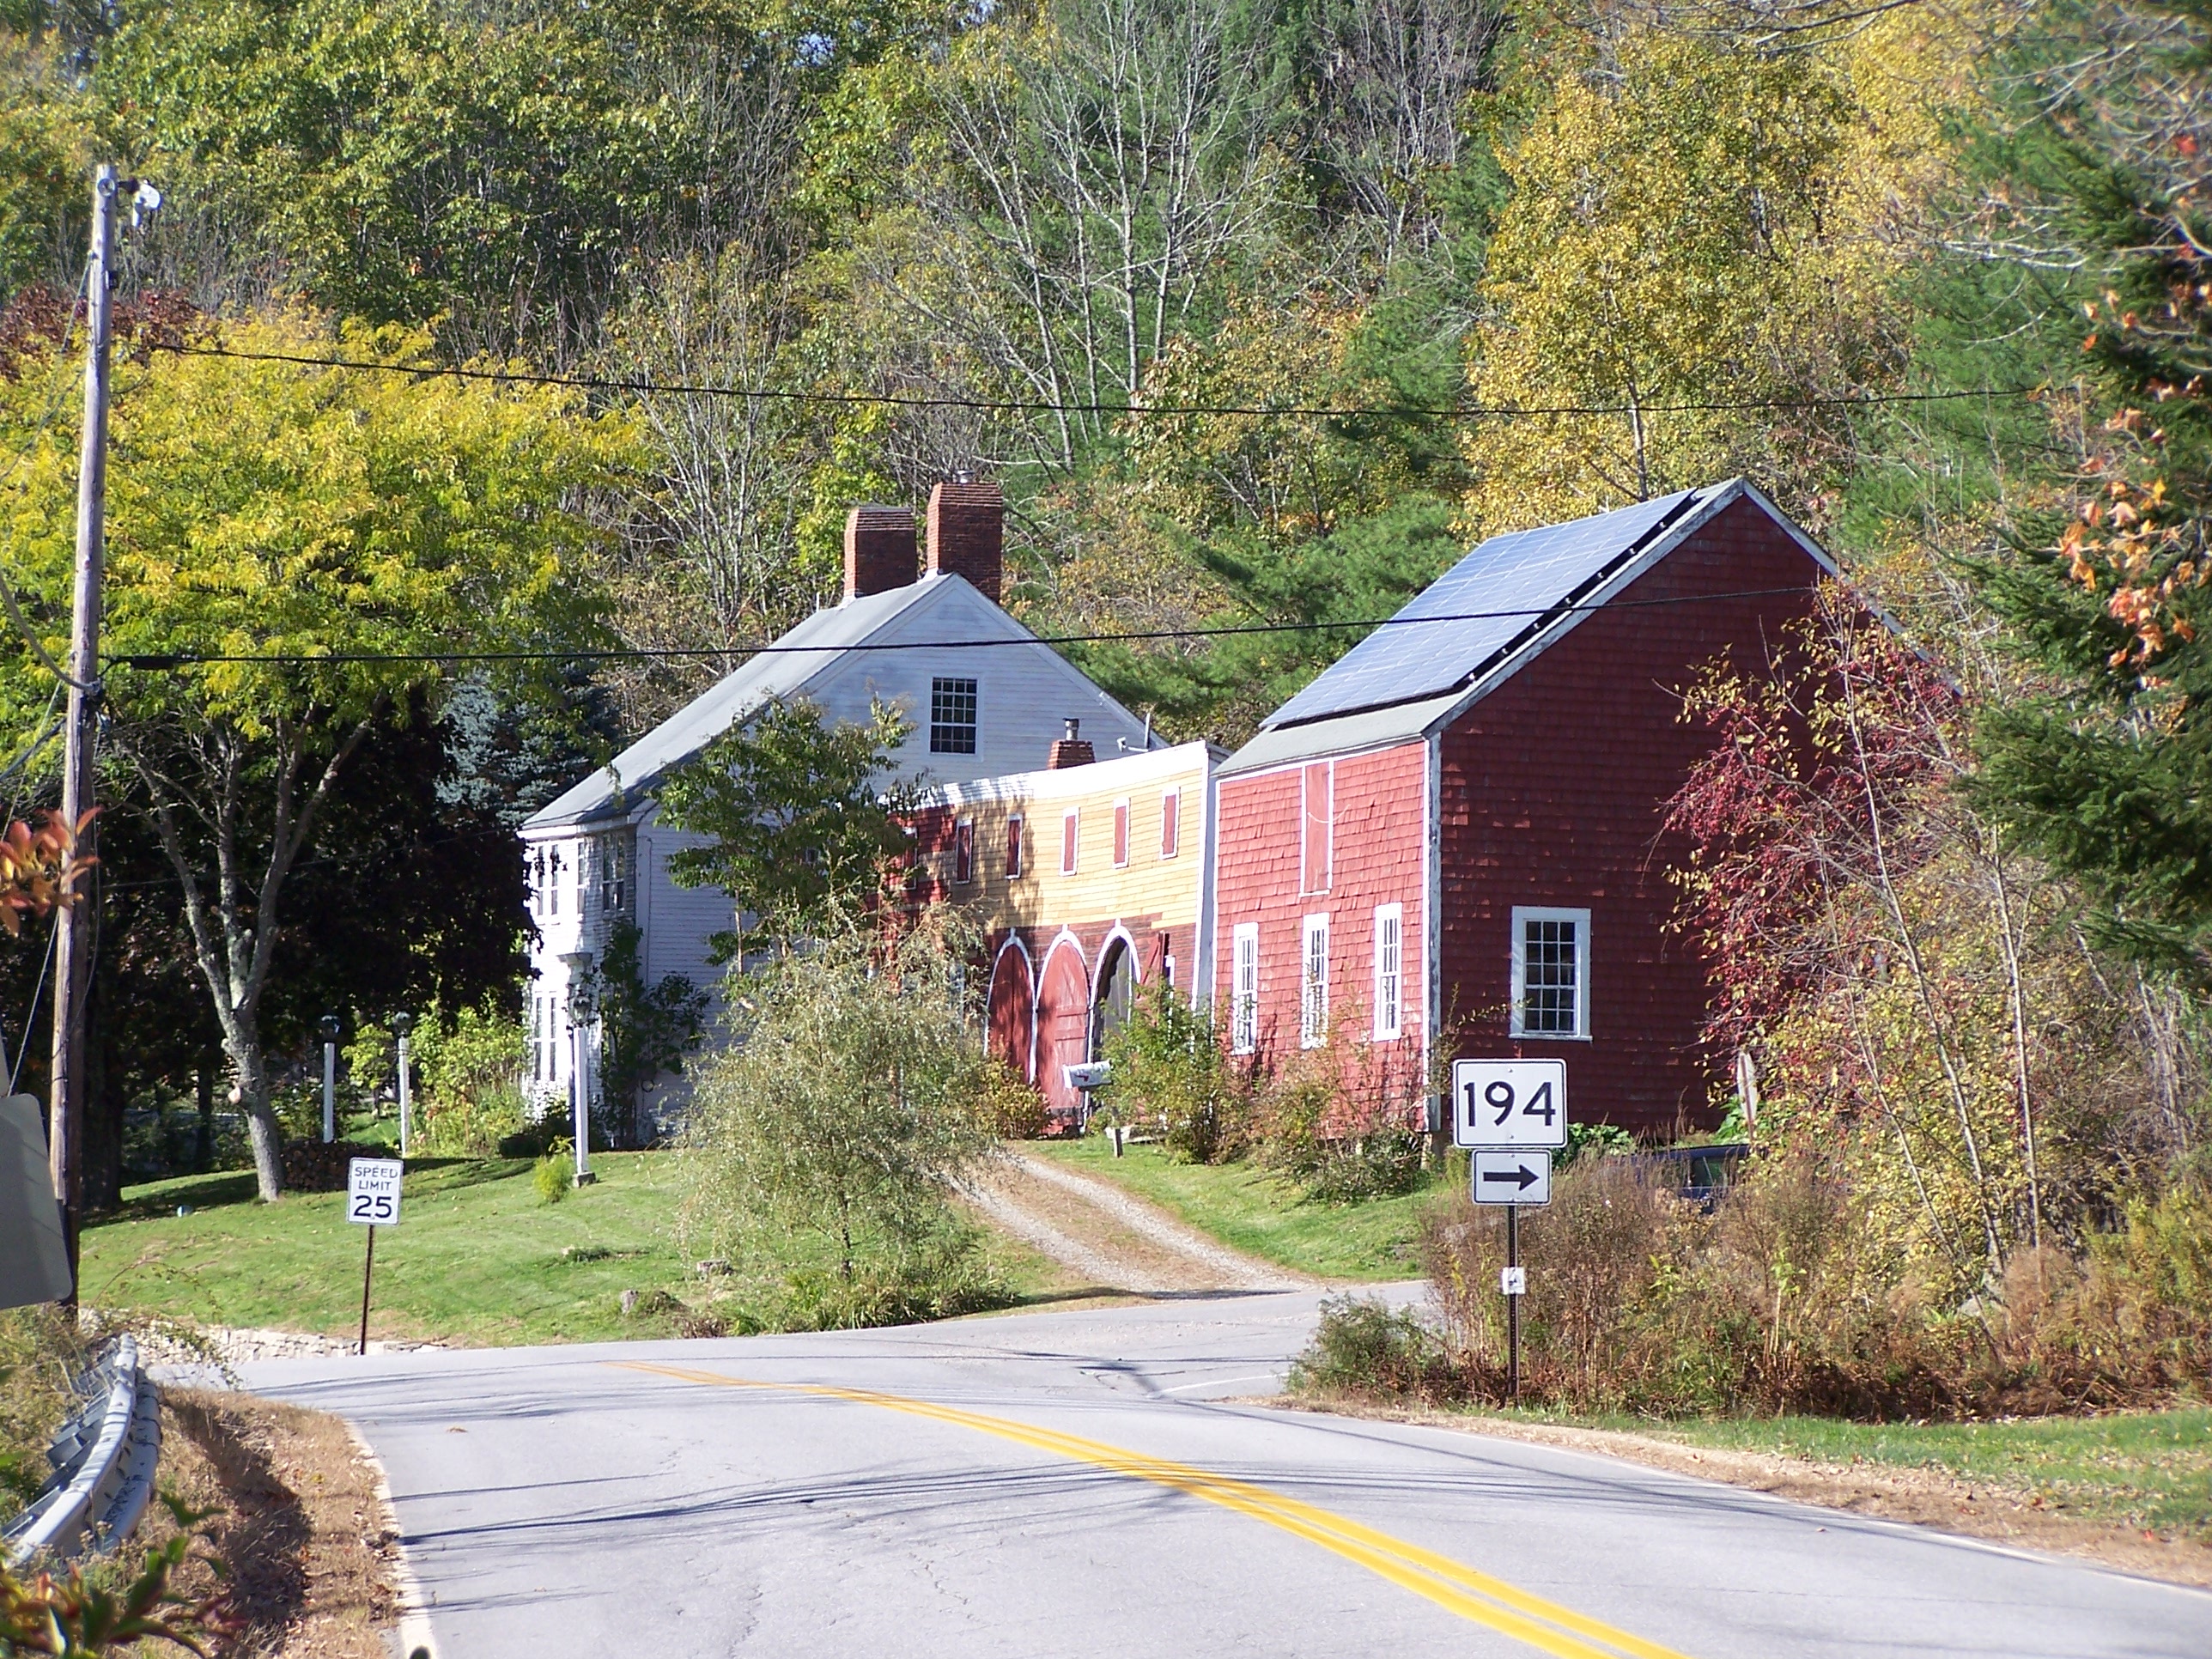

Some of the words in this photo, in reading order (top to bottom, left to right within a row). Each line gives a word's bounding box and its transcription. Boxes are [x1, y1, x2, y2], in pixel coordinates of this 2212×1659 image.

[1463, 1080, 1557, 1127] 194
[355, 1166, 398, 1179] SPEED
[358, 1180, 392, 1191] LIMIT
[353, 1194, 392, 1218] 25
